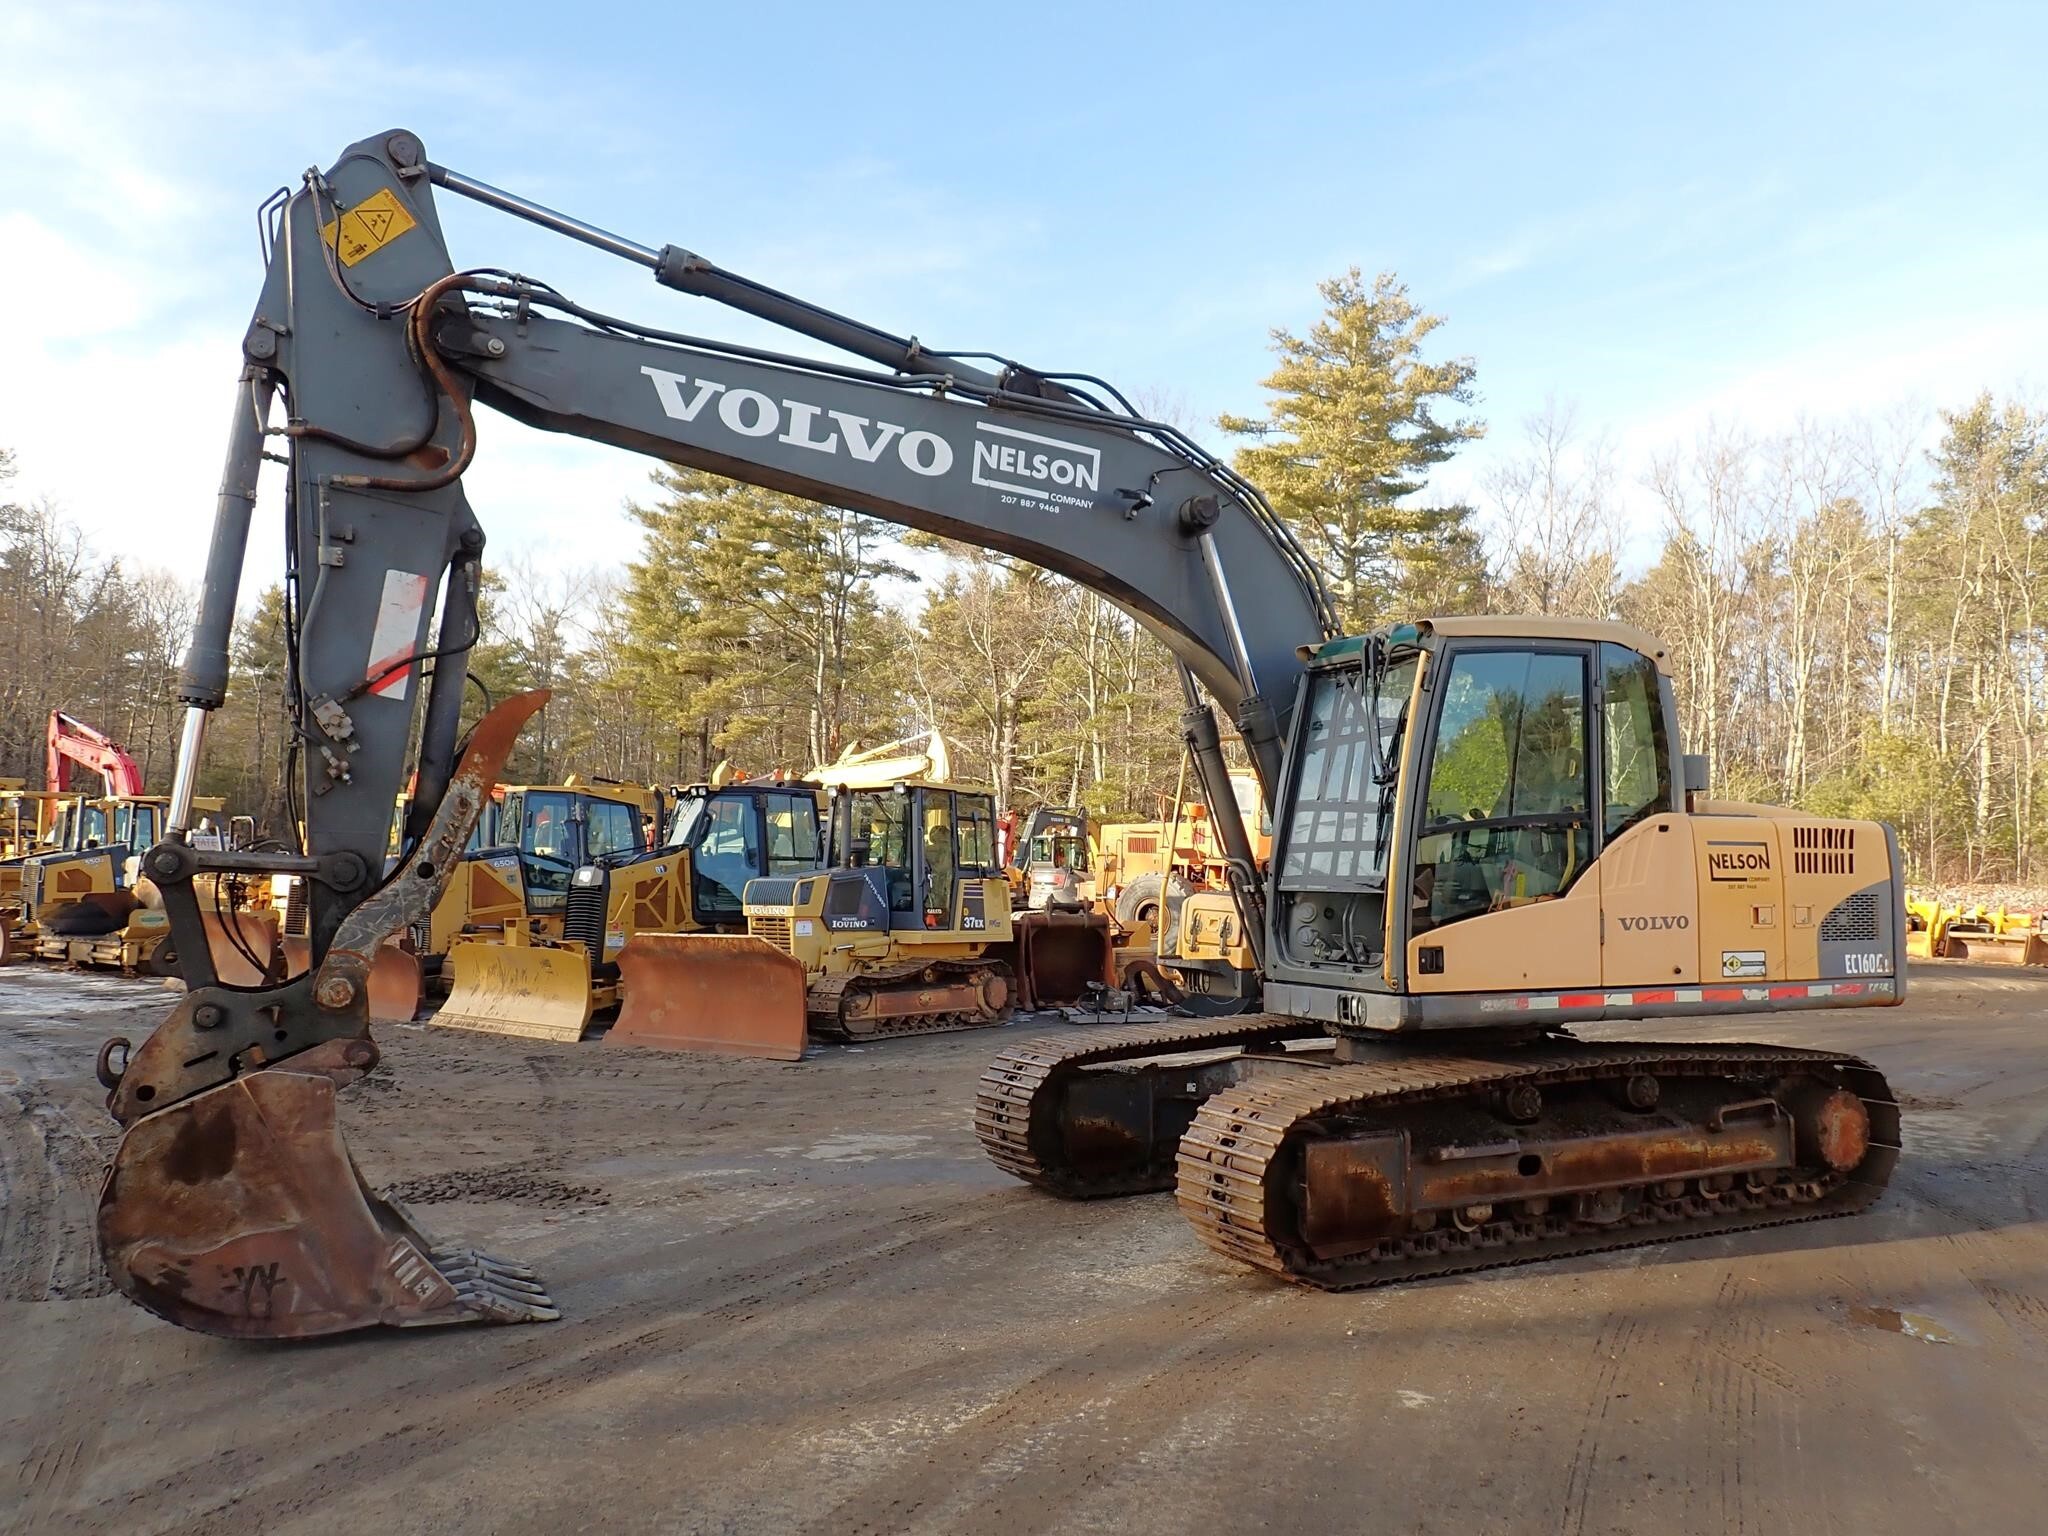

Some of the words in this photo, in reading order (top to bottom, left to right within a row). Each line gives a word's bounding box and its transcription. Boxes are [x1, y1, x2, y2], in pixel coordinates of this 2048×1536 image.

[640, 365, 954, 477] VOLVO
[973, 440, 1100, 492] NELSON
[1001, 495, 1017, 504] 207
[1020, 499, 1036, 508] 887
[1039, 503, 1060, 514] 9468
[1050, 493, 1094, 509] COMPANY
[1708, 853, 1770, 870] NELSON
[832, 920, 867, 929] IOVINO
[963, 917, 985, 928] 37EX
[1617, 915, 1689, 931] VOLVO
